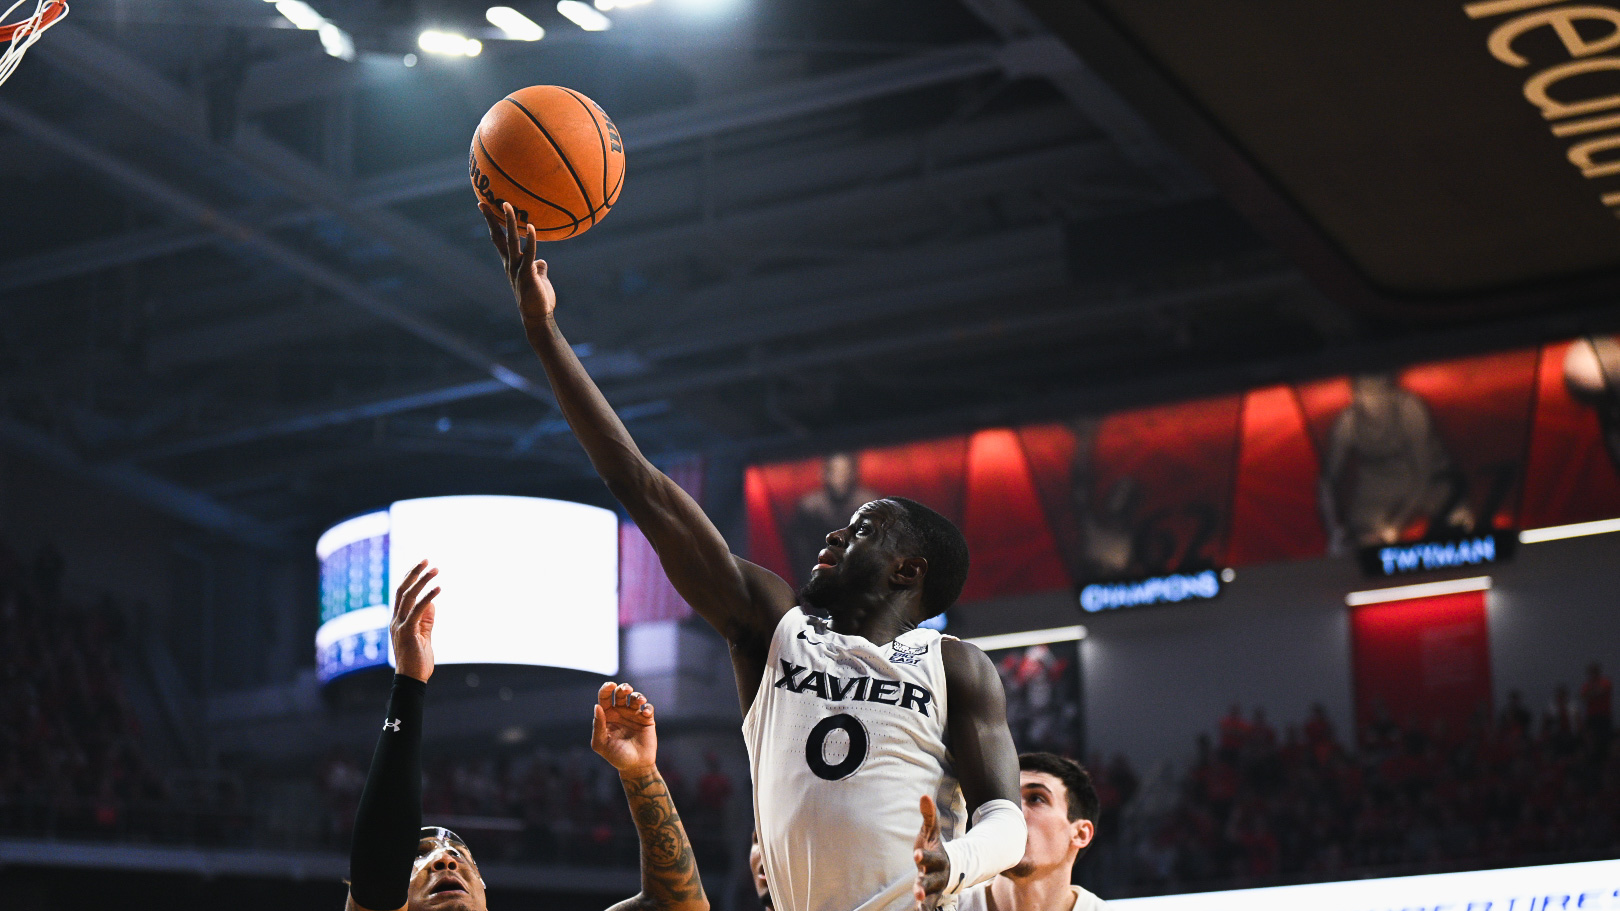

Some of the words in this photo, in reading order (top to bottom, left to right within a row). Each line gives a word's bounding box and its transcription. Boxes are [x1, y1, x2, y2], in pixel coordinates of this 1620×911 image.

[1079, 569, 1219, 612] CHAMPIONS
[889, 656, 921, 667] EAST
[774, 658, 933, 718] XAVIER
[805, 713, 870, 781] 0
